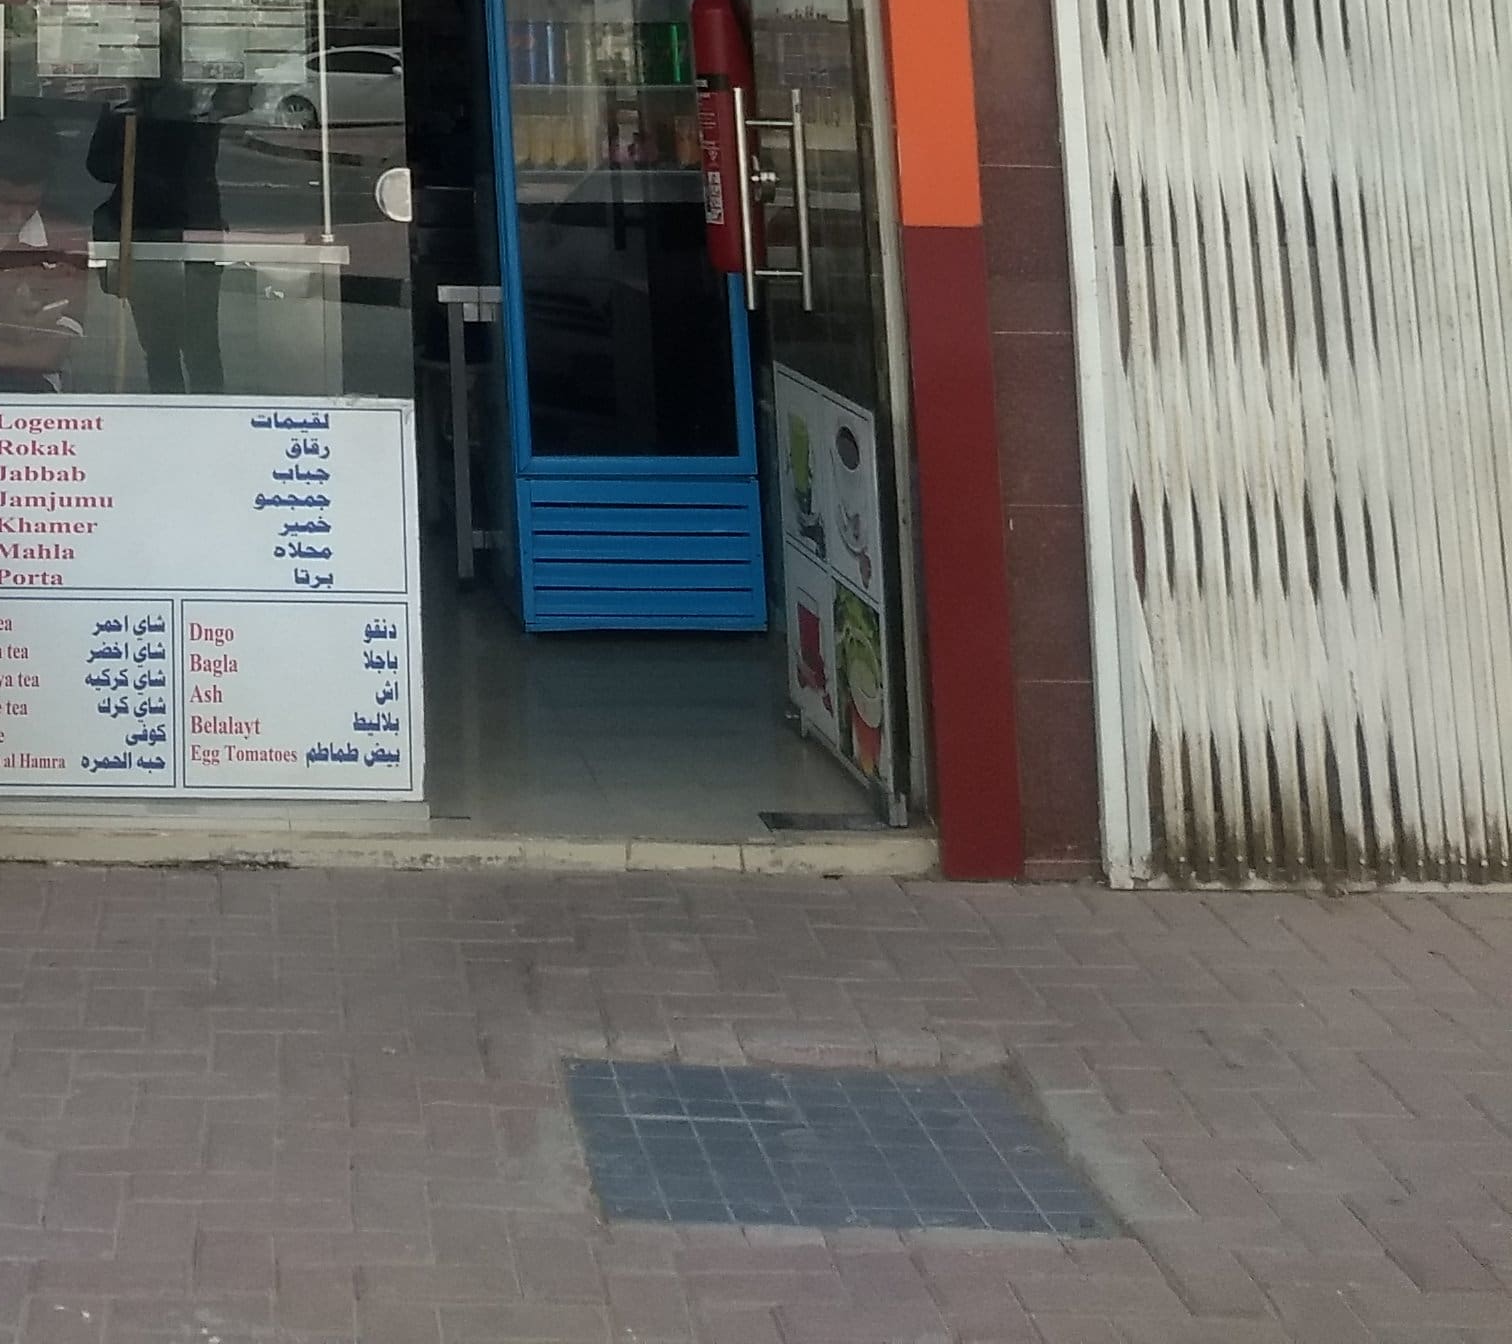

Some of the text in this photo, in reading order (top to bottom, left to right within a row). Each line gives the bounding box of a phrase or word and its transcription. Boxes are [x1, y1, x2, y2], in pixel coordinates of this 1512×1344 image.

[250, 412, 330, 433] لقيمات
[285, 438, 330, 459] رقاق
[272, 465, 330, 484] جباب
[253, 492, 331, 510] جمجمو
[278, 516, 331, 537] خمير
[273, 542, 332, 559] محلاه
[293, 568, 333, 588] برتا
[92, 615, 165, 640] شاي احمر
[189, 622, 234, 646] Dngo
[363, 619, 397, 643] دنقو
[7, 645, 28, 659] tea
[87, 642, 166, 667] شاي اخضر
[363, 650, 398, 674] باجلا
[190, 654, 237, 677] Bagla
[18, 673, 39, 687] tea
[85, 668, 166, 694] شاي كركيه
[190, 685, 223, 703] Ash
[376, 680, 398, 705] اش
[6, 701, 28, 715] tea
[98, 696, 166, 722] شاي كرك
[191, 715, 260, 739] Belalayt
[353, 712, 399, 736] بلاليط
[4, 753, 16, 768] al
[19, 753, 66, 768] Hamra
[81, 752, 166, 774] حبه الحمره
[191, 745, 297, 765] Egg Tomatoes
[306, 742, 400, 768] بيض طماطم
